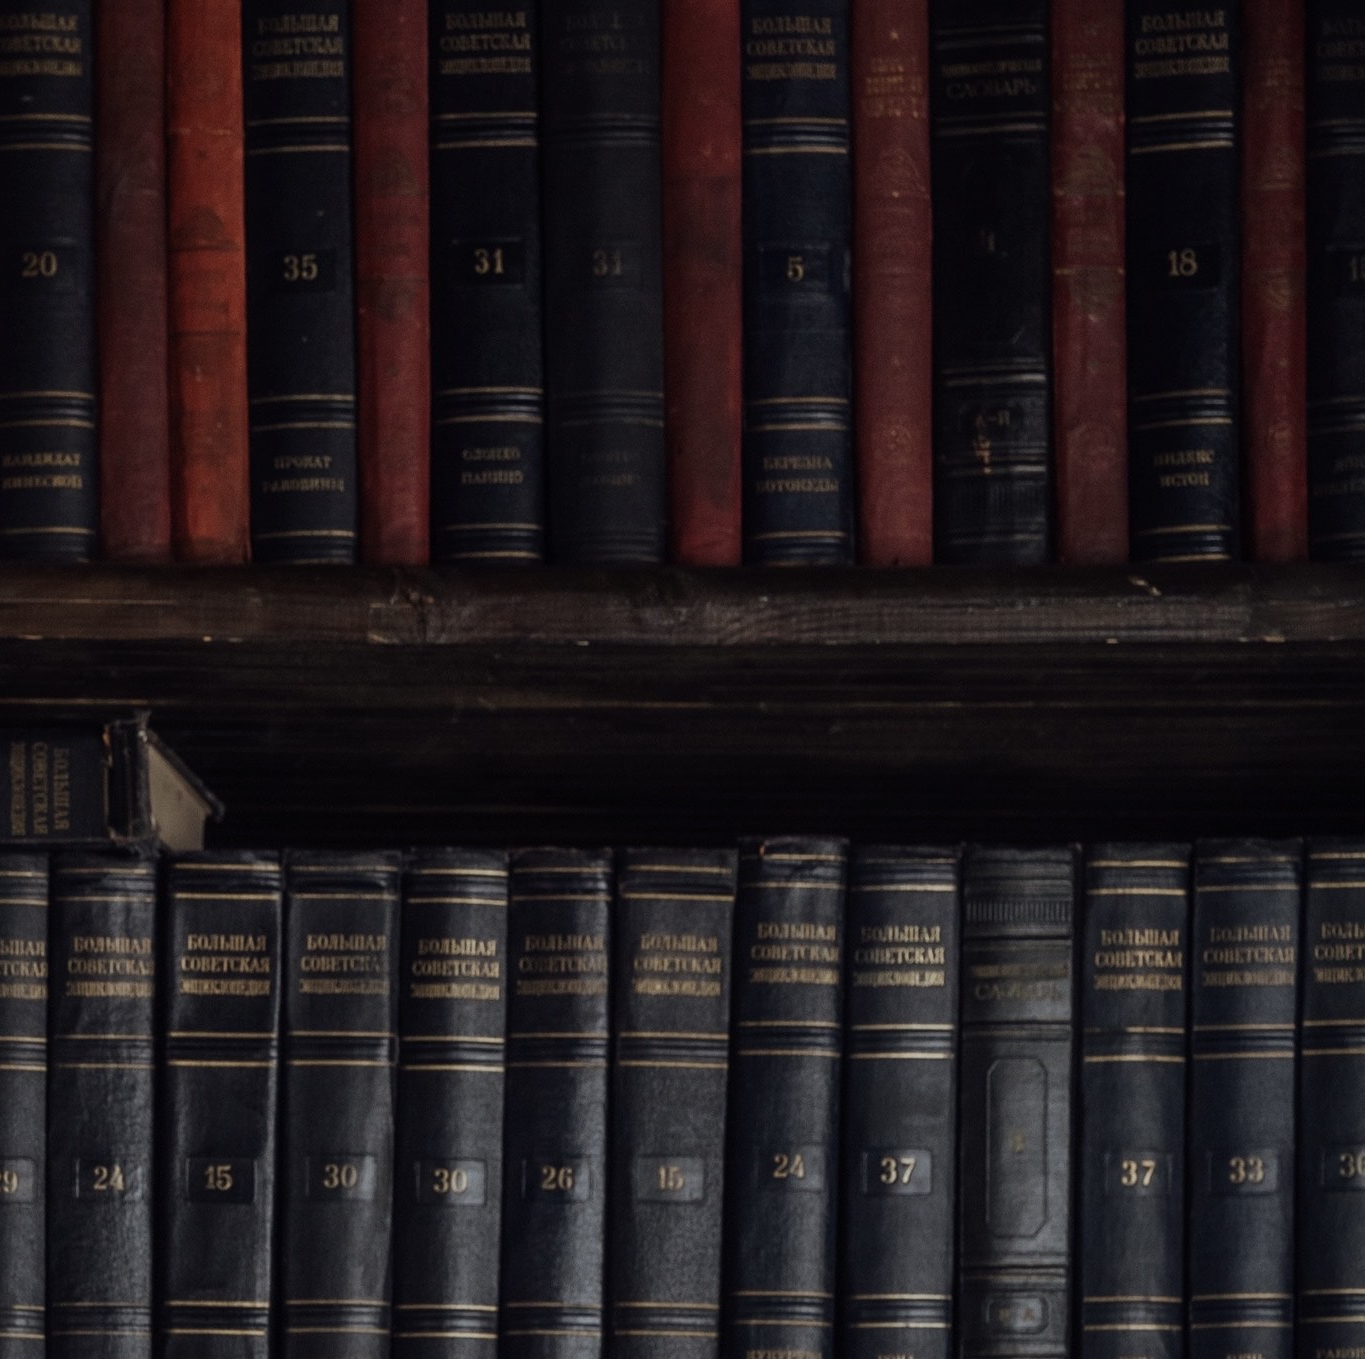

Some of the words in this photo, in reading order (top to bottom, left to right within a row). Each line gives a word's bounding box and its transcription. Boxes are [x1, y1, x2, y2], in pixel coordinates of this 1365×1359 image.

[21, 252, 59, 278] 20
[284, 255, 319, 281] 35
[475, 248, 505, 275] 31
[593, 251, 621, 277] 31
[785, 256, 806, 281] 5
[1167, 250, 1199, 278] 18
[186, 934, 268, 951] БОЛЬШАЯ
[305, 934, 388, 950] БОЛЬШАЯ
[524, 934, 606, 950] БОЛЬШАЯ
[639, 933, 720, 952] БОЛЬШАЯ
[863, 925, 943, 942] БОЛЬШАЯ
[1101, 928, 1181, 945] БОЛЬШАЯ
[1211, 925, 1292, 940] БОЛЬШАЯ
[72, 936, 154, 952] БОЛЬШАЯ
[417, 938, 499, 955] БОЛЬШАЯ
[1202, 948, 1295, 962] СОВЕТСКАЯ
[179, 956, 272, 972] СОВЕТСКАЯ
[634, 957, 723, 972] СОВЕТСКАЯ
[856, 947, 947, 965] СОВЕТСКАЯ
[1093, 951, 1184, 967] СОВЕТСКАЯ
[68, 960, 155, 976] СОВЕТСКАЯ
[413, 961, 501, 977] СОВЕТСКАЯ
[205, 1163, 234, 1191] 15
[322, 1163, 358, 1189] 30
[772, 1154, 806, 1179] 24
[879, 1156, 917, 1184] 37
[1120, 1158, 1157, 1186] 37
[1228, 1156, 1265, 1184] 33
[92, 1166, 125, 1192] 24
[432, 1168, 468, 1194] 30
[540, 1165, 575, 1191] 26
[657, 1164, 685, 1192] 15
